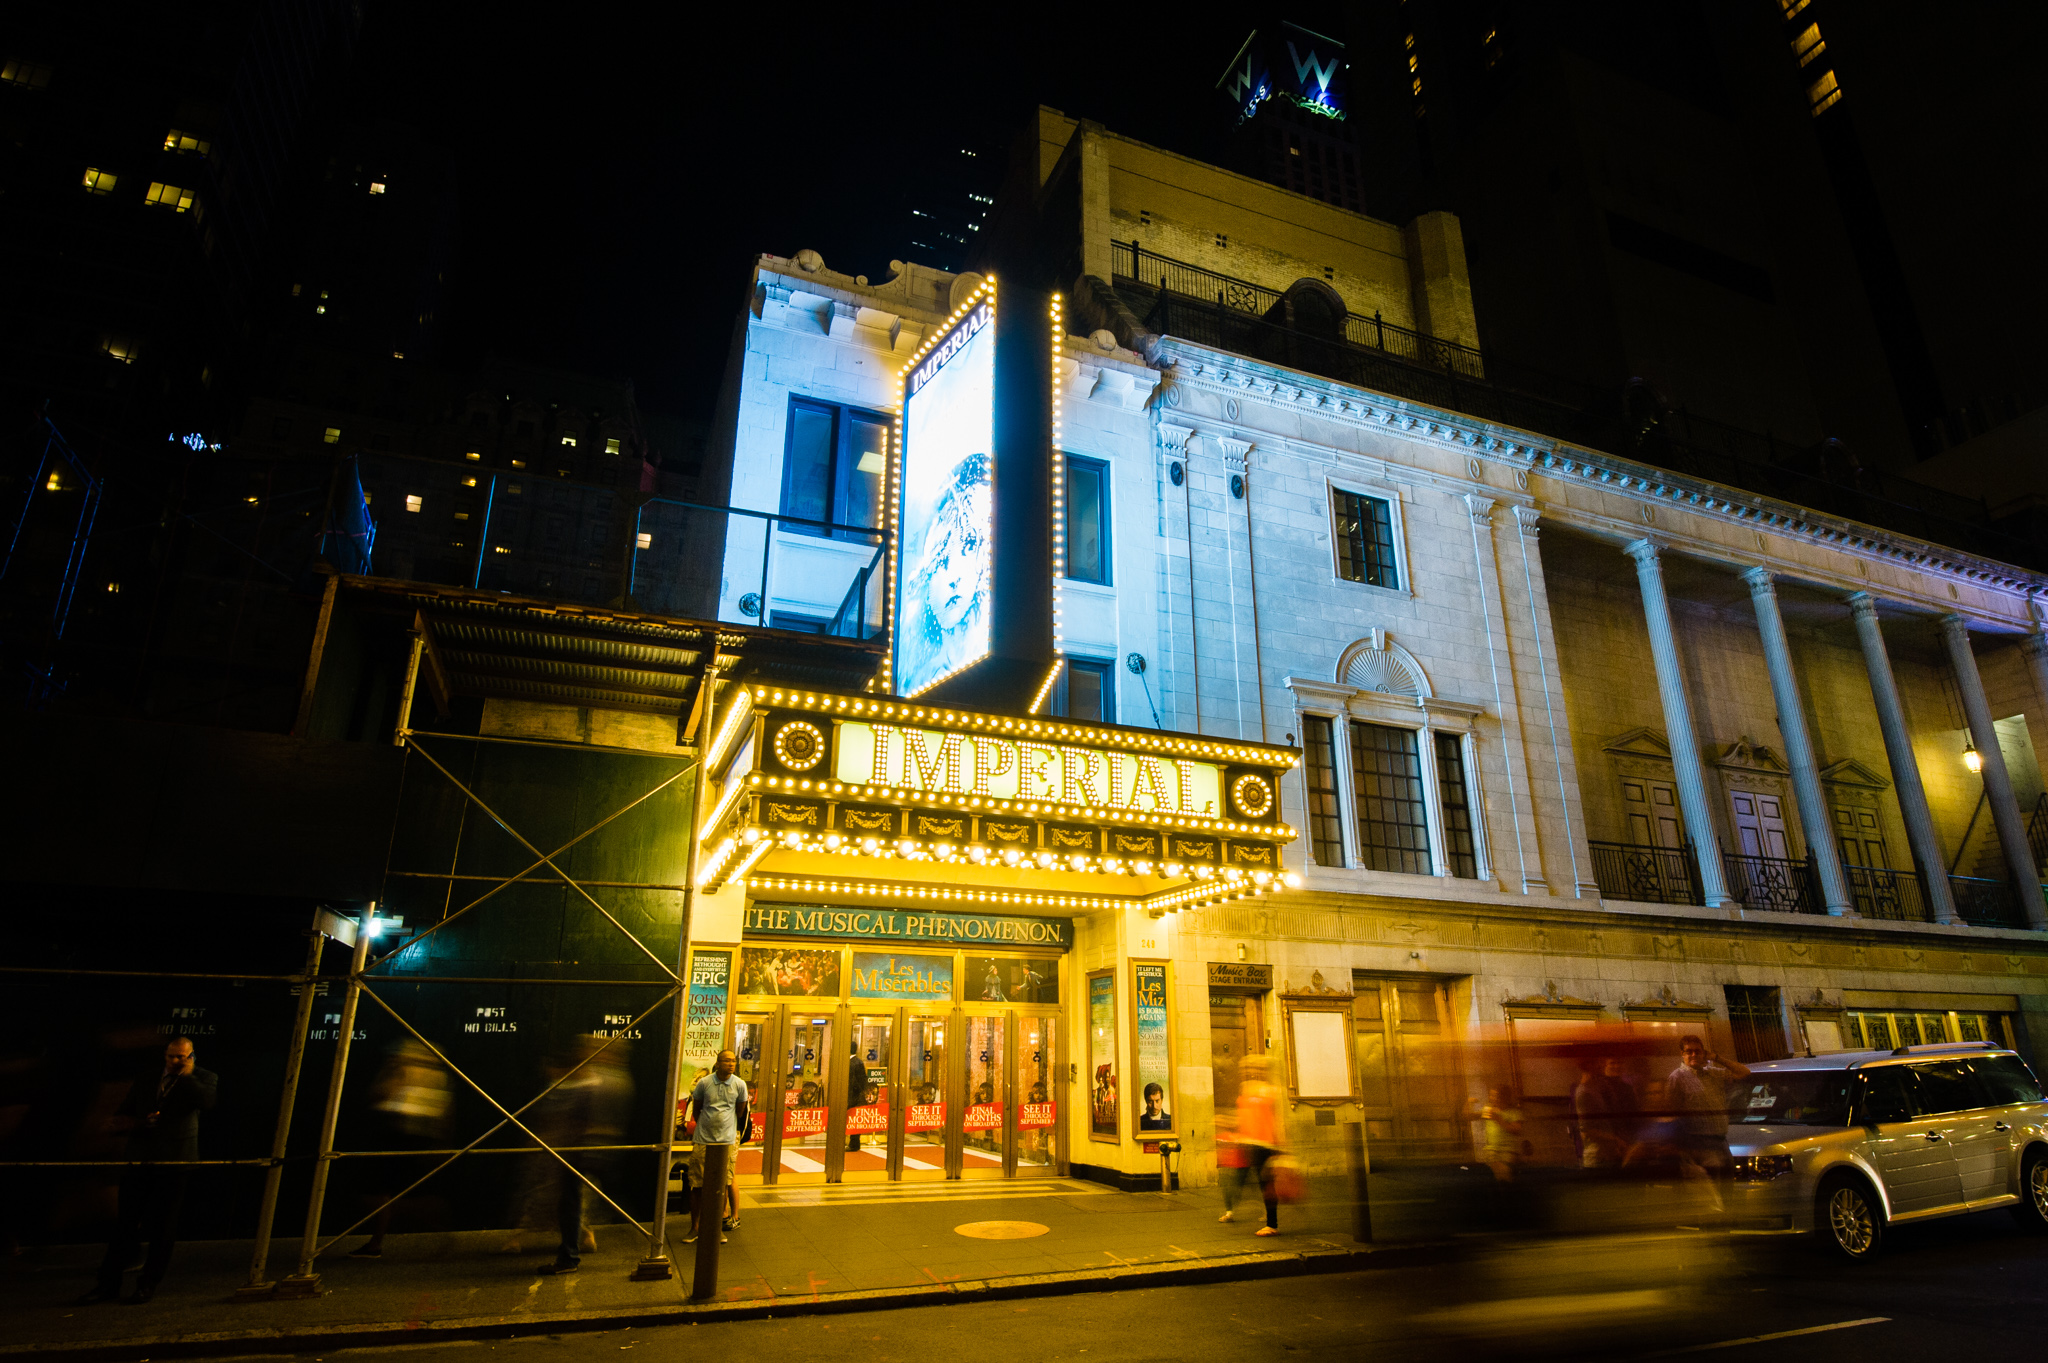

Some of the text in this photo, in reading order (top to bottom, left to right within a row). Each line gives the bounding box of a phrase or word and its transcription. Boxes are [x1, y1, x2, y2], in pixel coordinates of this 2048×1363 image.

[1286, 40, 1340, 93] W
[1226, 53, 1252, 103] W
[913, 304, 993, 394] IMPERIAL
[867, 722, 1214, 820] IMPERIAL
[743, 908, 1064, 943] THE MUSICAL PHENOMENON.
[1141, 939, 1155, 948] 249
[888, 958, 914, 977] Les
[1209, 964, 1266, 977] Music Box
[853, 968, 951, 994] Misérables
[1140, 976, 1162, 992] Les
[1137, 991, 1165, 1007] Miz
[171, 1008, 207, 1018] POST
[476, 1008, 506, 1017] POST
[324, 1013, 340, 1024] PO
[603, 1014, 632, 1024] POST
[686, 1016, 721, 1028] JONES
[179, 1024, 216, 1034] BILLS
[464, 1021, 517, 1033] NO BILLS
[310, 1029, 326, 1040] NO
[593, 1029, 607, 1039] NO
[855, 1107, 880, 1115] FINAL
[911, 1105, 942, 1114] SEE IT
[971, 1106, 994, 1114] FINAL
[1023, 1104, 1052, 1113] SEE IT
[790, 1110, 823, 1119] SEE IT
[848, 1115, 887, 1123] MONTHS
[965, 1113, 1001, 1121] MONTHS
